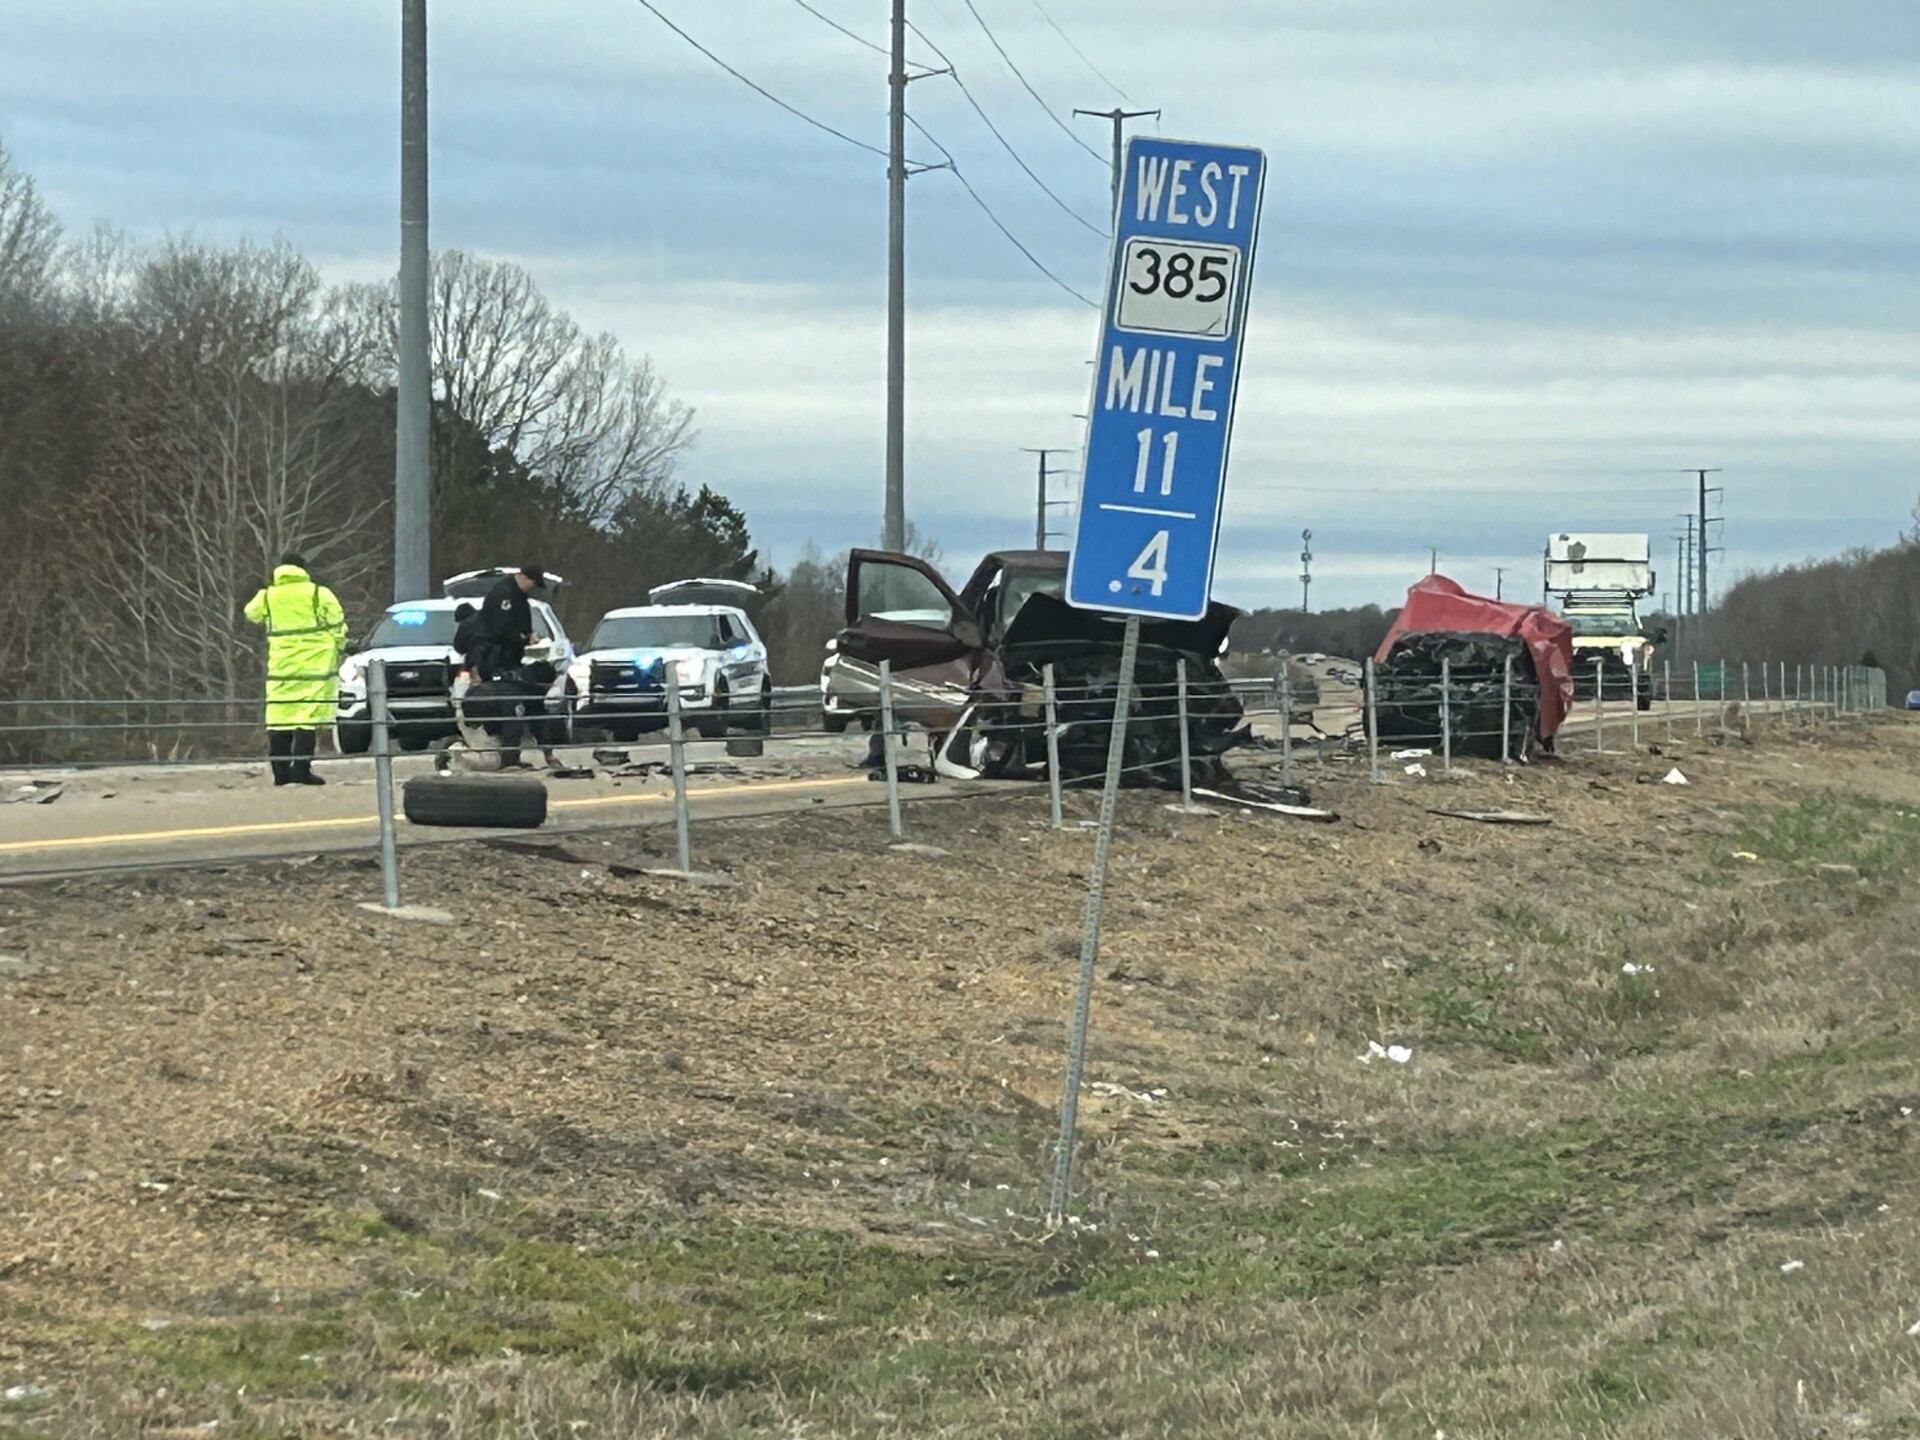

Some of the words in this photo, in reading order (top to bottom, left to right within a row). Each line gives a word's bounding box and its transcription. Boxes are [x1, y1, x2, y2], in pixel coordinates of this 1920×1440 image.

[1135, 156, 1249, 229] WEST
[1129, 248, 1228, 302] 385
[1105, 345, 1223, 421] MILE
[1133, 428, 1178, 495] 11
